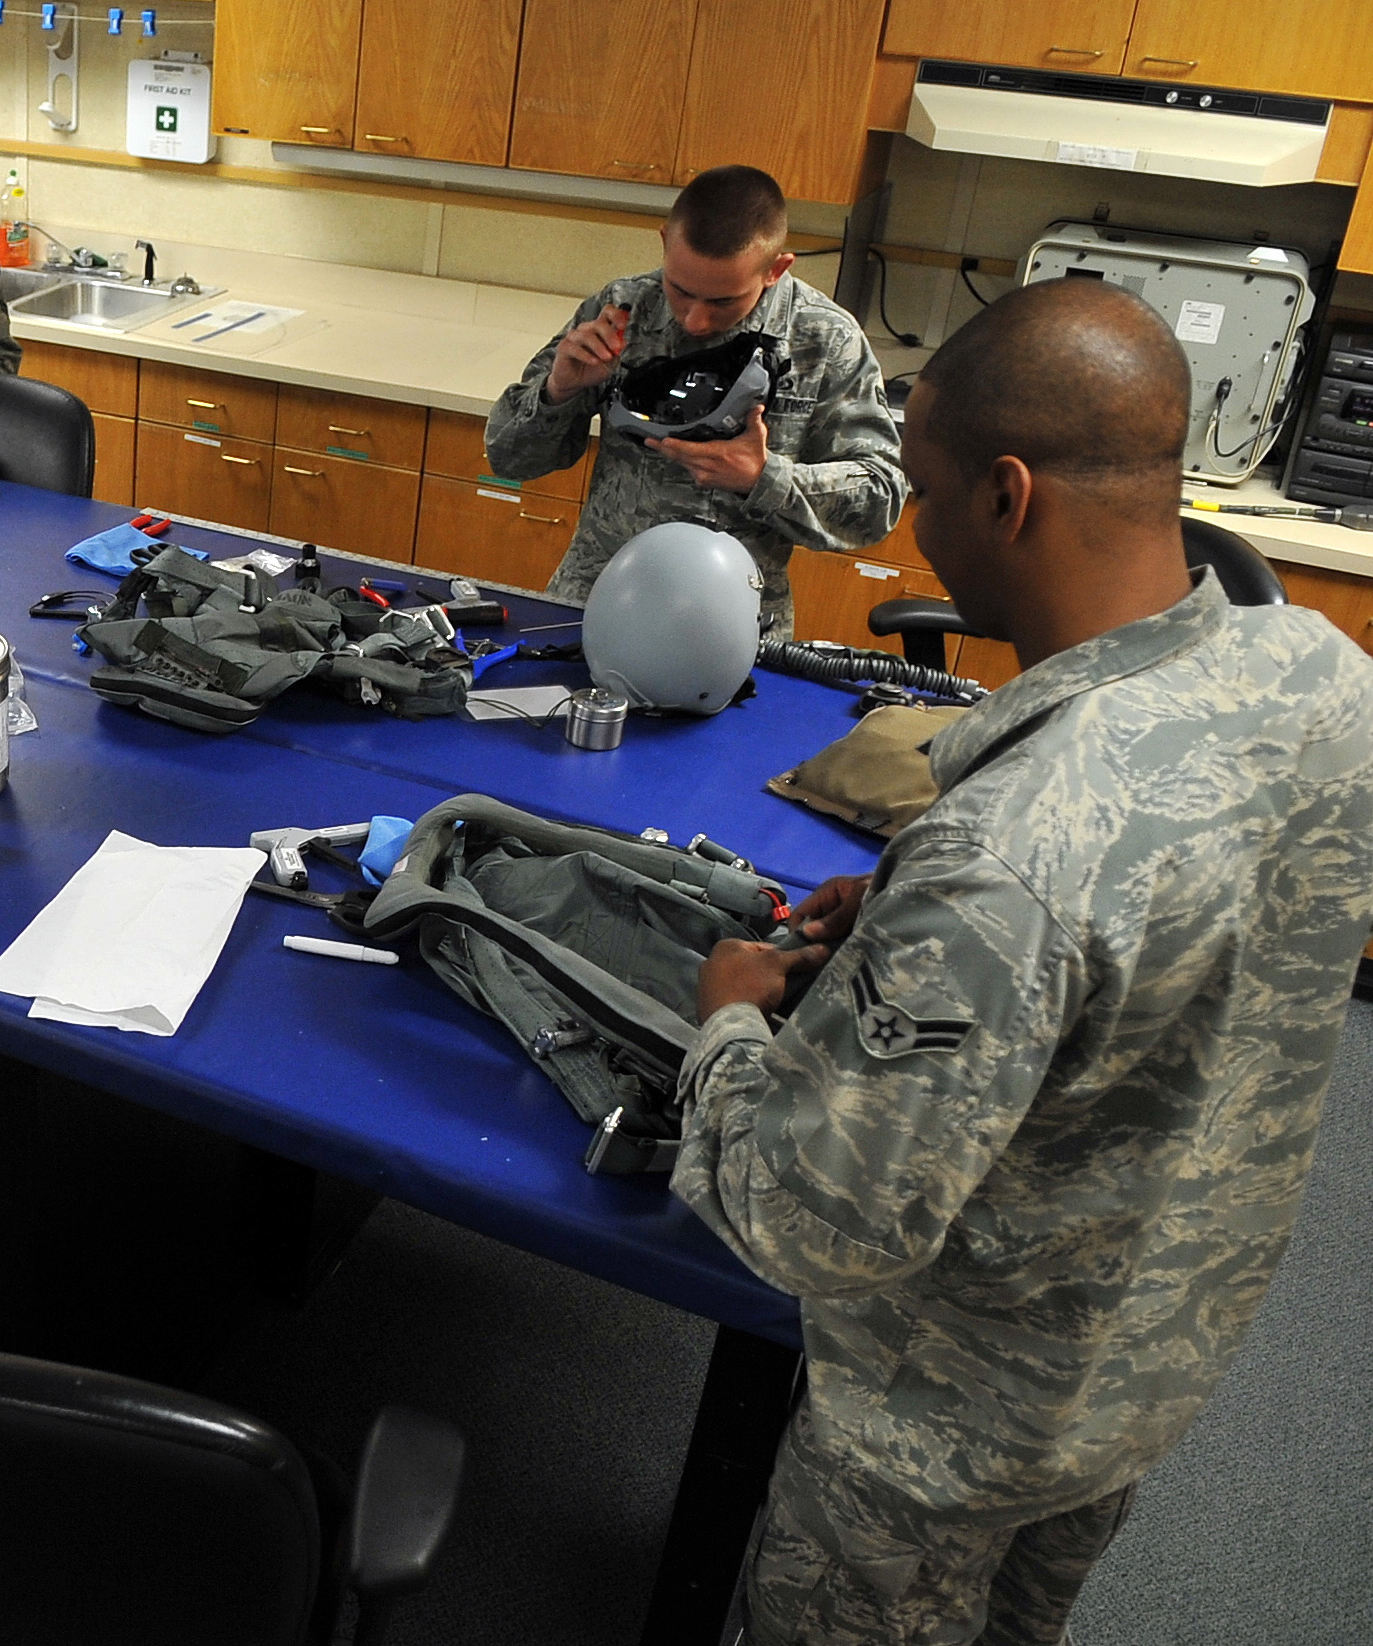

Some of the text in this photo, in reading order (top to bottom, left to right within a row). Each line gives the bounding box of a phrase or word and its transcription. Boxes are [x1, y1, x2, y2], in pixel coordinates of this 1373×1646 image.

[144, 84, 192, 96] FIRST AID KIT
